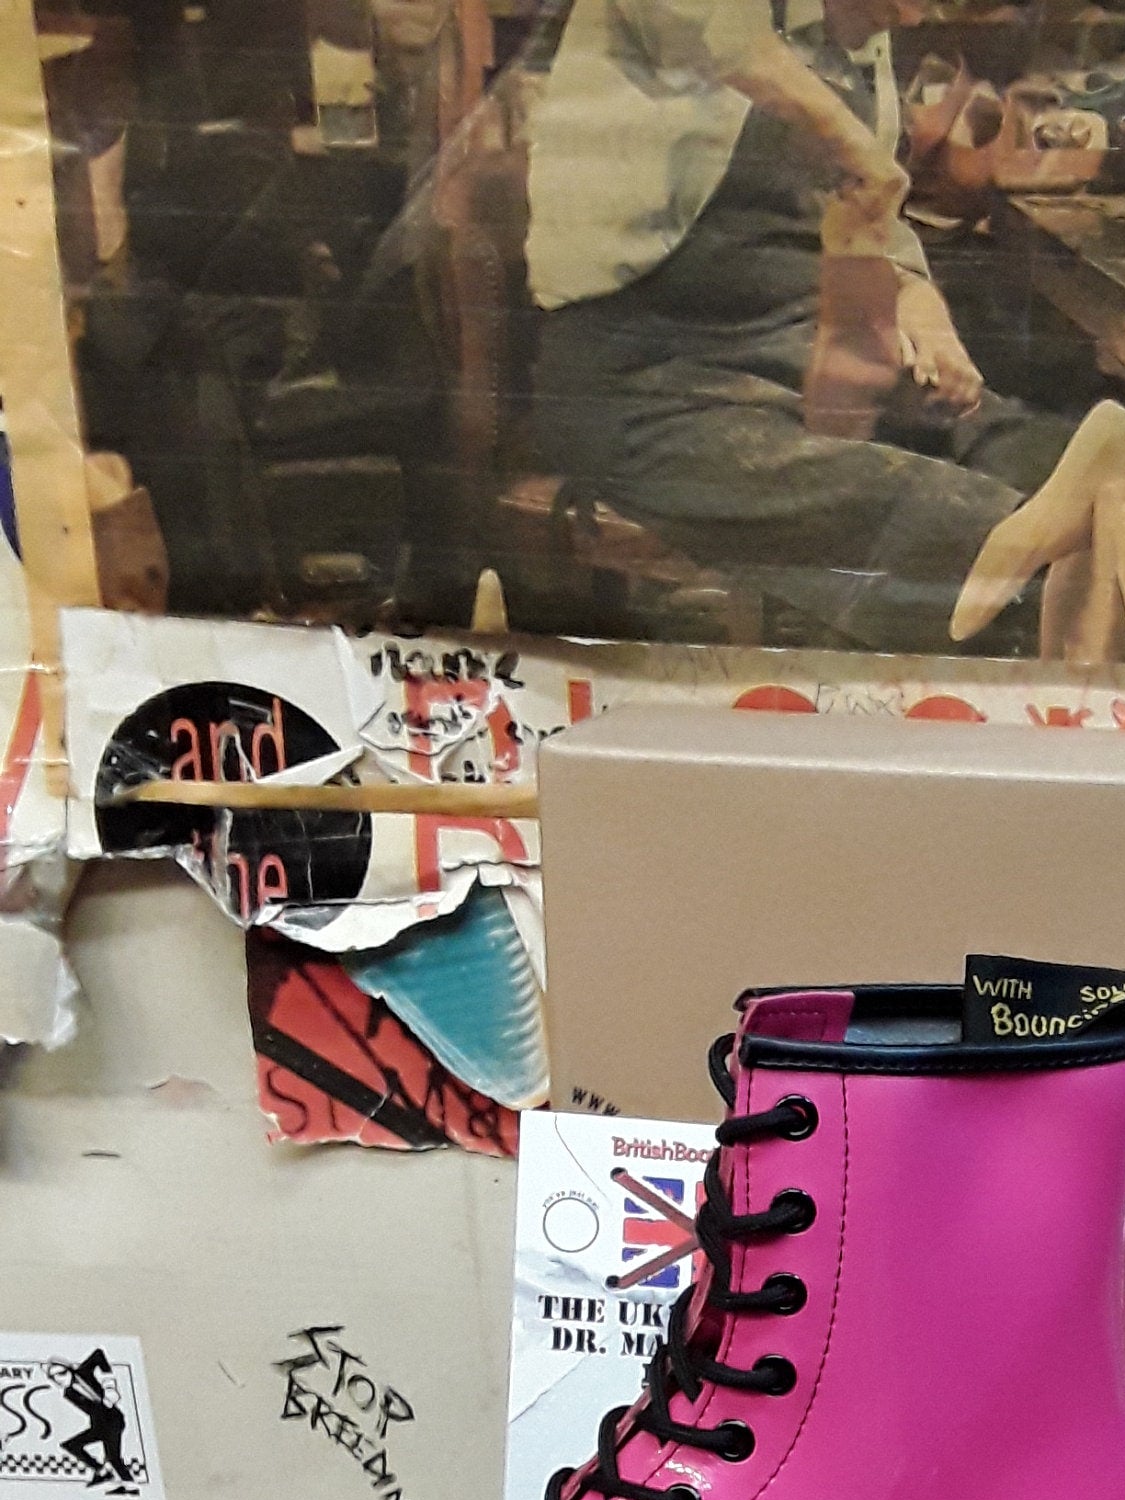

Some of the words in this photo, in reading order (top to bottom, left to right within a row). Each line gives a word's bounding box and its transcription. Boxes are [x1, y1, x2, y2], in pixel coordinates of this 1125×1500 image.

[170, 696, 286, 782] and
[972, 975, 1033, 1000] WITH
[612, 1135, 714, 1164] BritishBoo
[538, 1294, 606, 1325] THE
[551, 1326, 606, 1354] DR.
